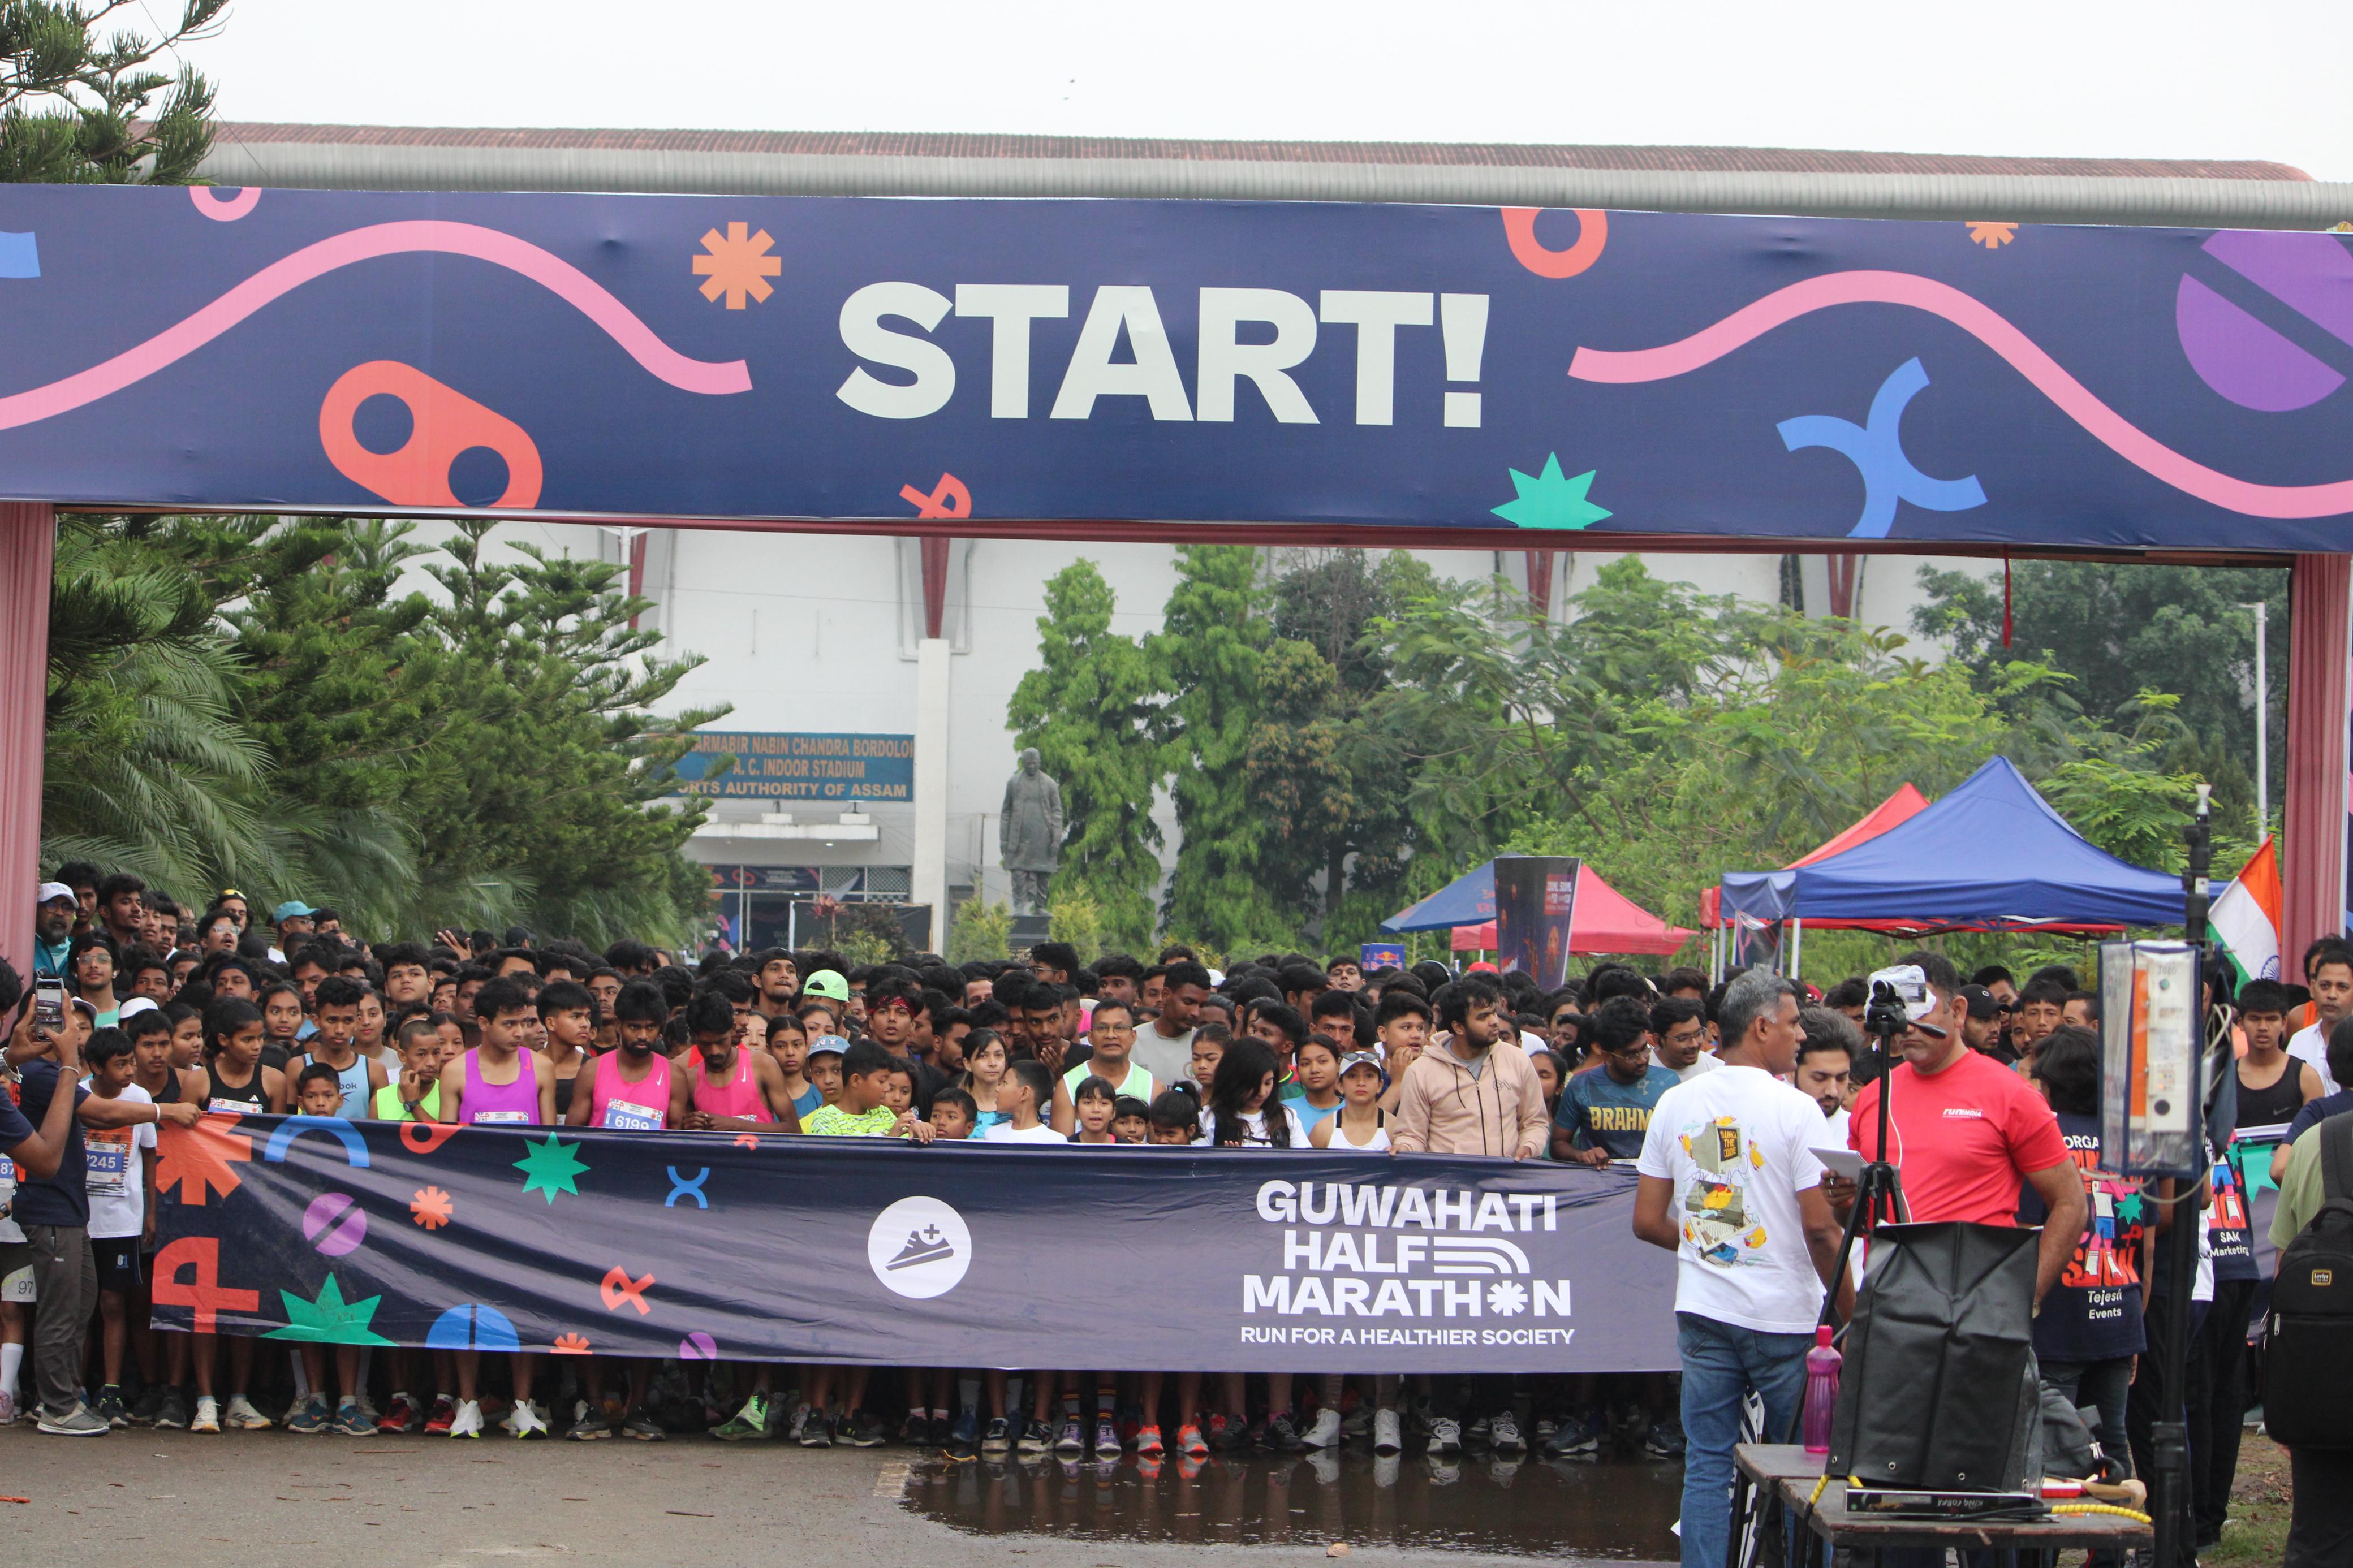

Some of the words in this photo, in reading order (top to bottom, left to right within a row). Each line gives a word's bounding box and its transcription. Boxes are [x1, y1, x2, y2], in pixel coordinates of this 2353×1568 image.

[835, 281, 1490, 428] START!
[687, 735, 748, 753] ARMABIR
[752, 736, 788, 755] NABIN
[792, 737, 850, 756] CHANDRA
[763, 758, 809, 777] INDOOR
[812, 759, 865, 779] STADIUM
[678, 781, 721, 794] ORTS
[725, 781, 820, 796] AUTHORITY
[824, 783, 846, 796] OF
[850, 783, 907, 797] ASSAM
[1589, 1106, 1653, 1131] BRAHM
[1724, 1139, 1735, 1148] THE
[2063, 1135, 2100, 1149] ORGA
[1256, 1180, 1557, 1232] GUWAHATI
[1284, 1229, 1428, 1273] HALF
[2089, 1307, 2122, 1319] Events
[1240, 1327, 1286, 1344] RUN
[1291, 1327, 1335, 1344] FOR
[1339, 1328, 1356, 1344] A
[1360, 1329, 1477, 1345] HEALTHIER
[1481, 1329, 1575, 1345] SOCIETY
